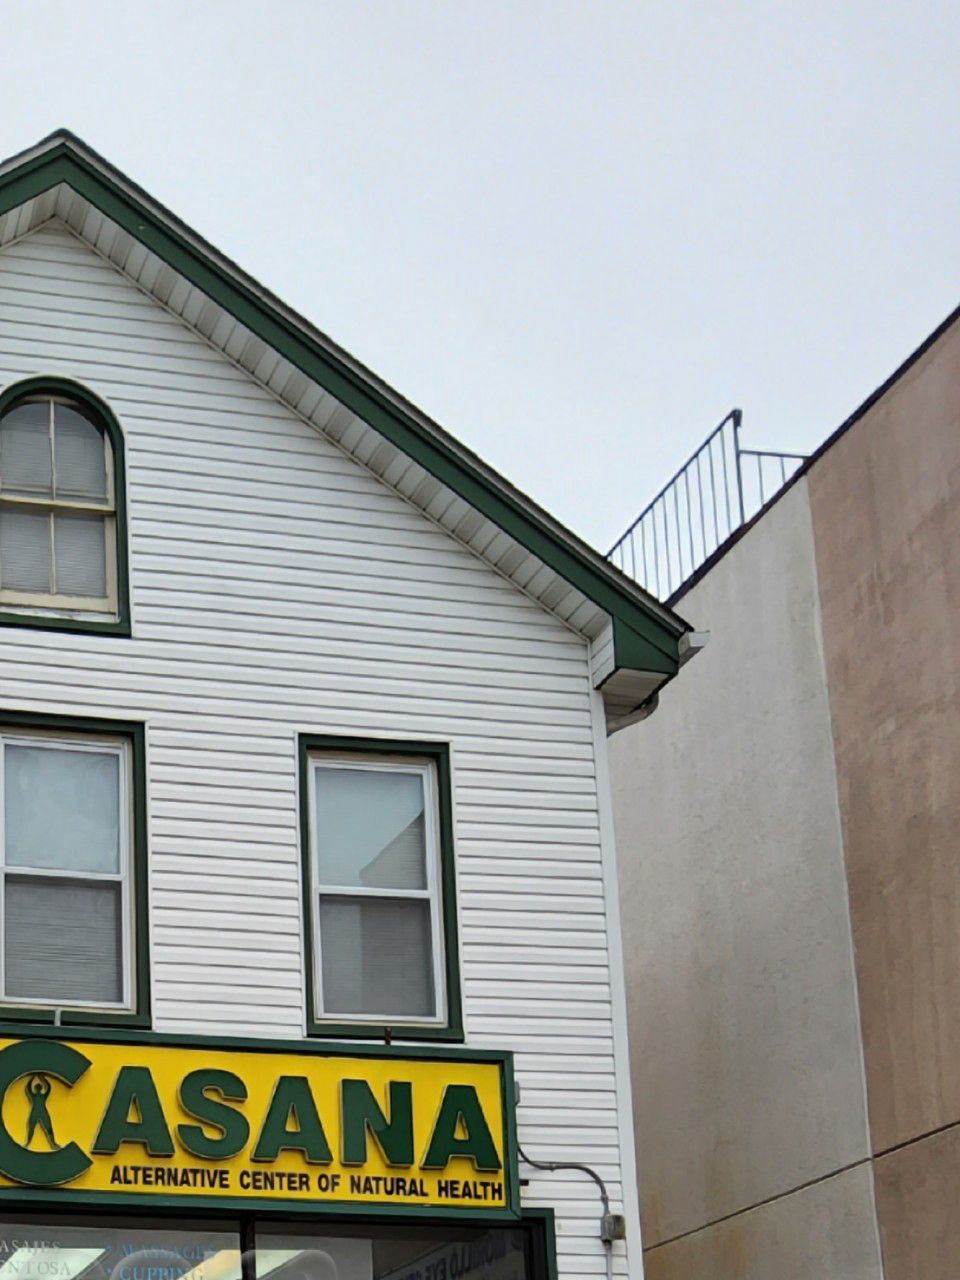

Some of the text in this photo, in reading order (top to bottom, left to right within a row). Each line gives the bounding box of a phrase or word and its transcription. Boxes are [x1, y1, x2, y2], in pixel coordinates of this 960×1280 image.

[110, 1165, 503, 1201] ALTERNATIVE CENTER OF NATURAL HEALTH
